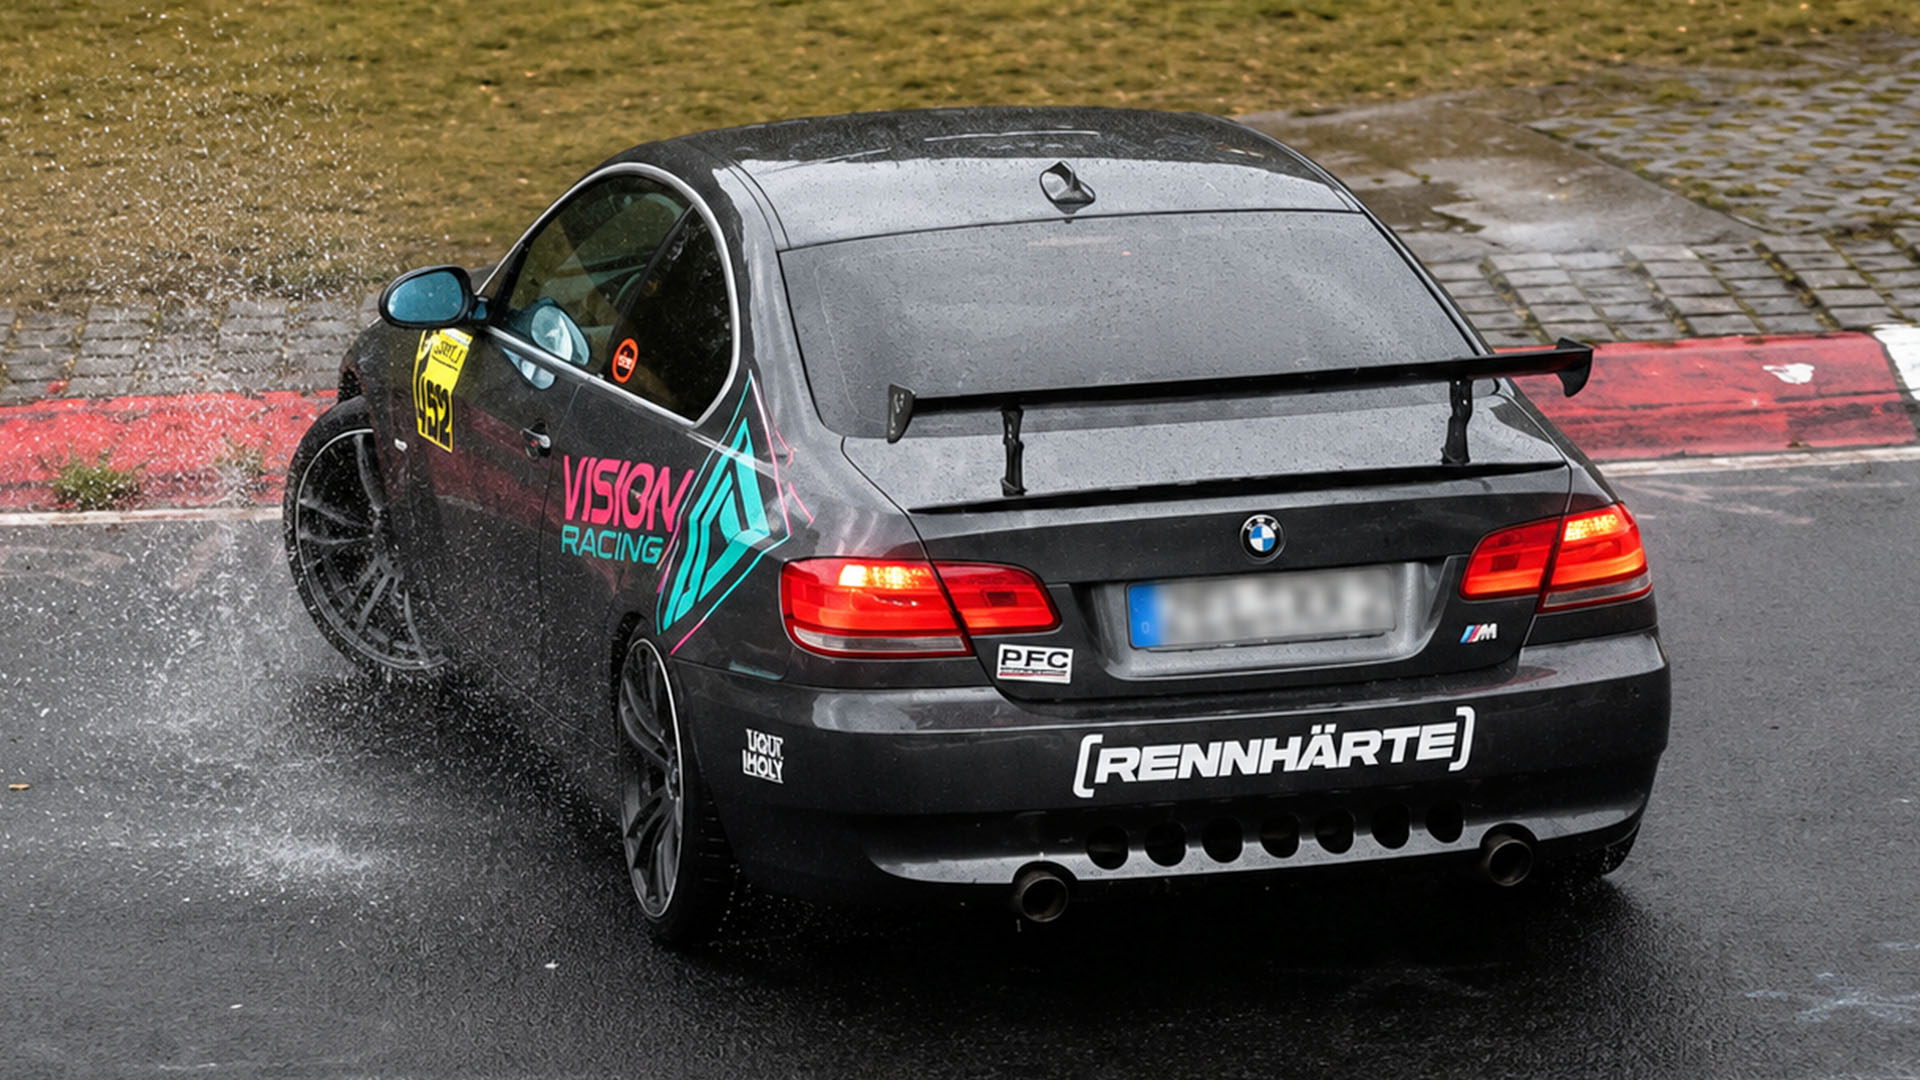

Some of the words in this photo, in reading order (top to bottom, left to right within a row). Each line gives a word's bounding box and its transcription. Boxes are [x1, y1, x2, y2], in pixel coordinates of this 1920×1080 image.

[563, 454, 695, 533] VISION
[561, 524, 664, 564] RACING
[1001, 648, 1069, 669] PFC
